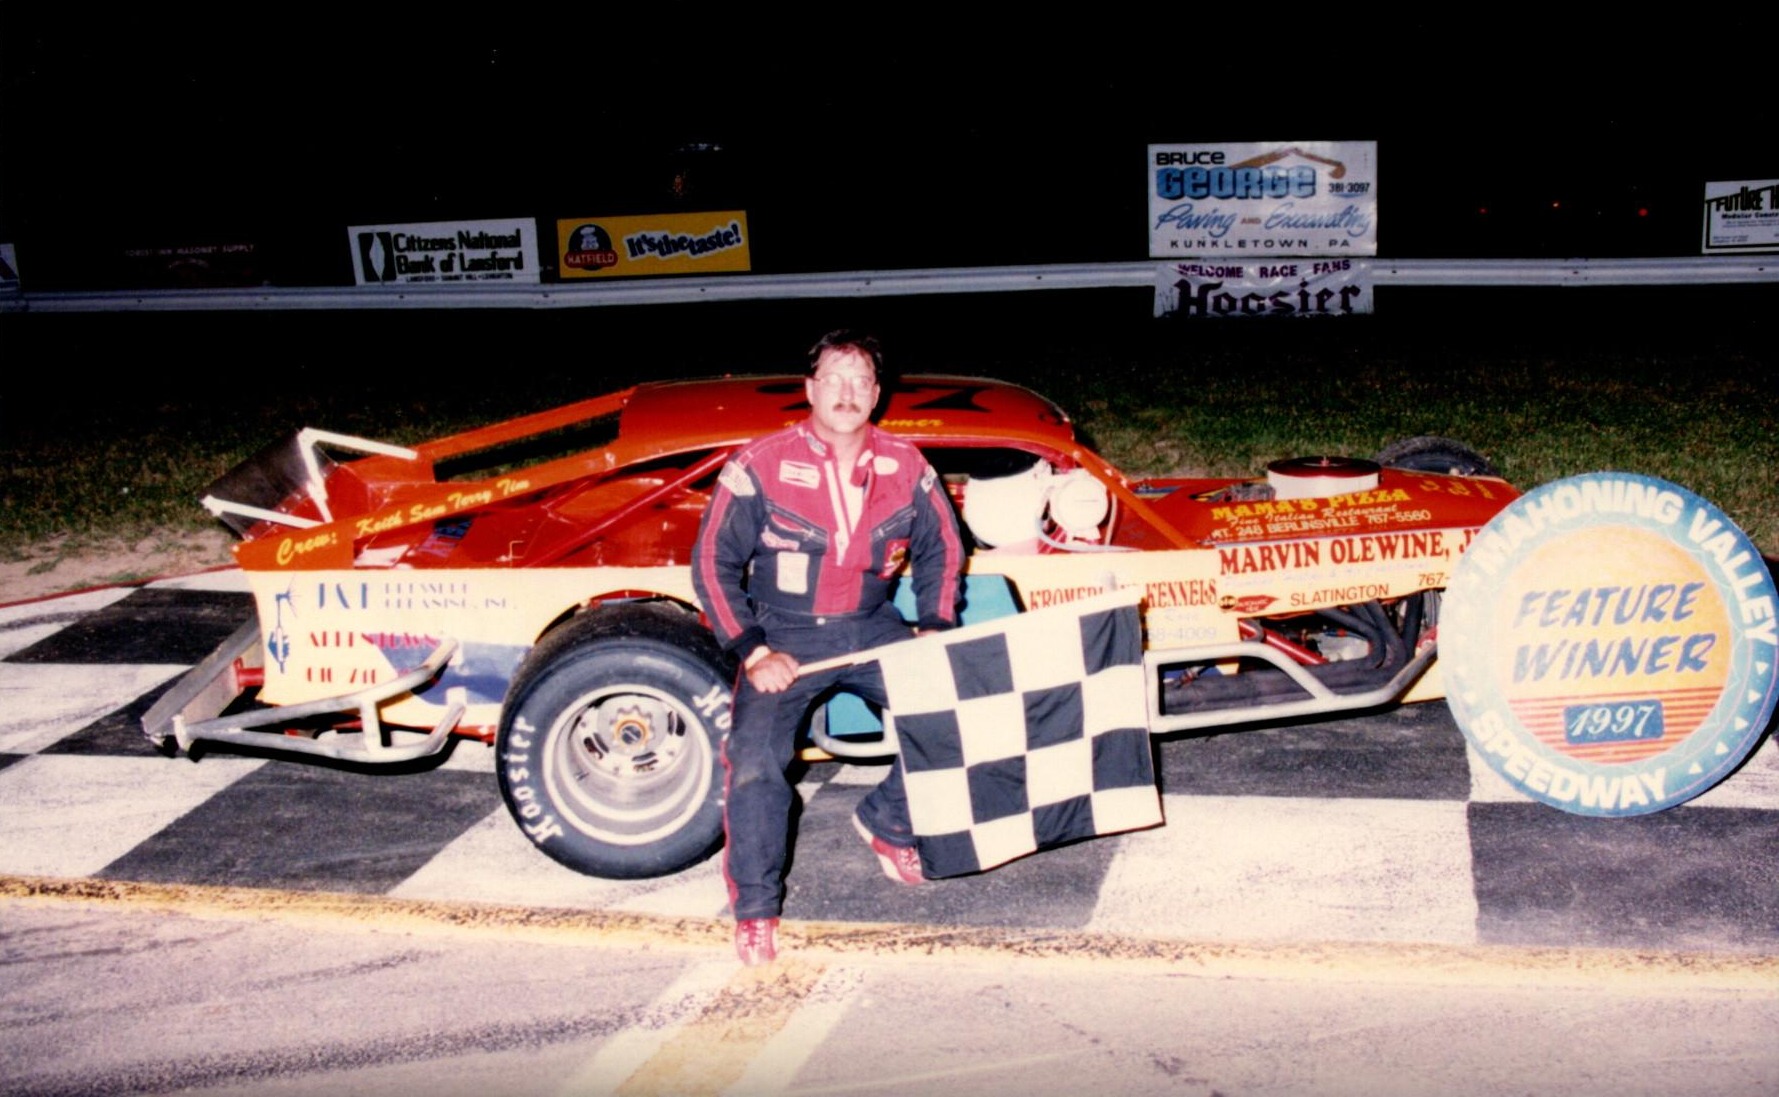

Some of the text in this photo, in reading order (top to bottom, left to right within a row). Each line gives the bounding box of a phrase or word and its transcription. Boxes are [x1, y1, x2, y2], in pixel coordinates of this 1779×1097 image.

[1715, 186, 1764, 212] FUTURE
[1155, 203, 1237, 238] Paving
[393, 228, 522, 253] Citizens National
[396, 250, 524, 275] Bank of Lansford
[566, 252, 615, 265] HATFIELD
[1177, 259, 1352, 278] WELCOME RACE FANS
[1173, 277, 1362, 317] Hoosier
[1211, 497, 1318, 521] MAMA'S
[1327, 488, 1412, 510] PIZZA
[1320, 503, 1398, 520] Restaurant
[275, 531, 338, 566] Crew:
[356, 510, 404, 537] Keith
[409, 503, 448, 525] Sam
[496, 479, 531, 495] Tim
[1266, 516, 1360, 535] BERLINSVILLE
[1219, 539, 1321, 576] MARVIN
[1330, 531, 1450, 566] OLEWINE,
[1469, 480, 1778, 646] MAHONING VALLEY
[1145, 578, 1218, 609] KENNELS
[1290, 584, 1391, 607] SLATINGTON
[1418, 573, 1451, 587] 767-
[1512, 581, 1706, 630] FEATURE
[1511, 632, 1717, 685] WINNER
[1568, 704, 1657, 738] 1997
[1470, 709, 1669, 810] SPEEDWAY
[502, 715, 565, 844] Hoosier
